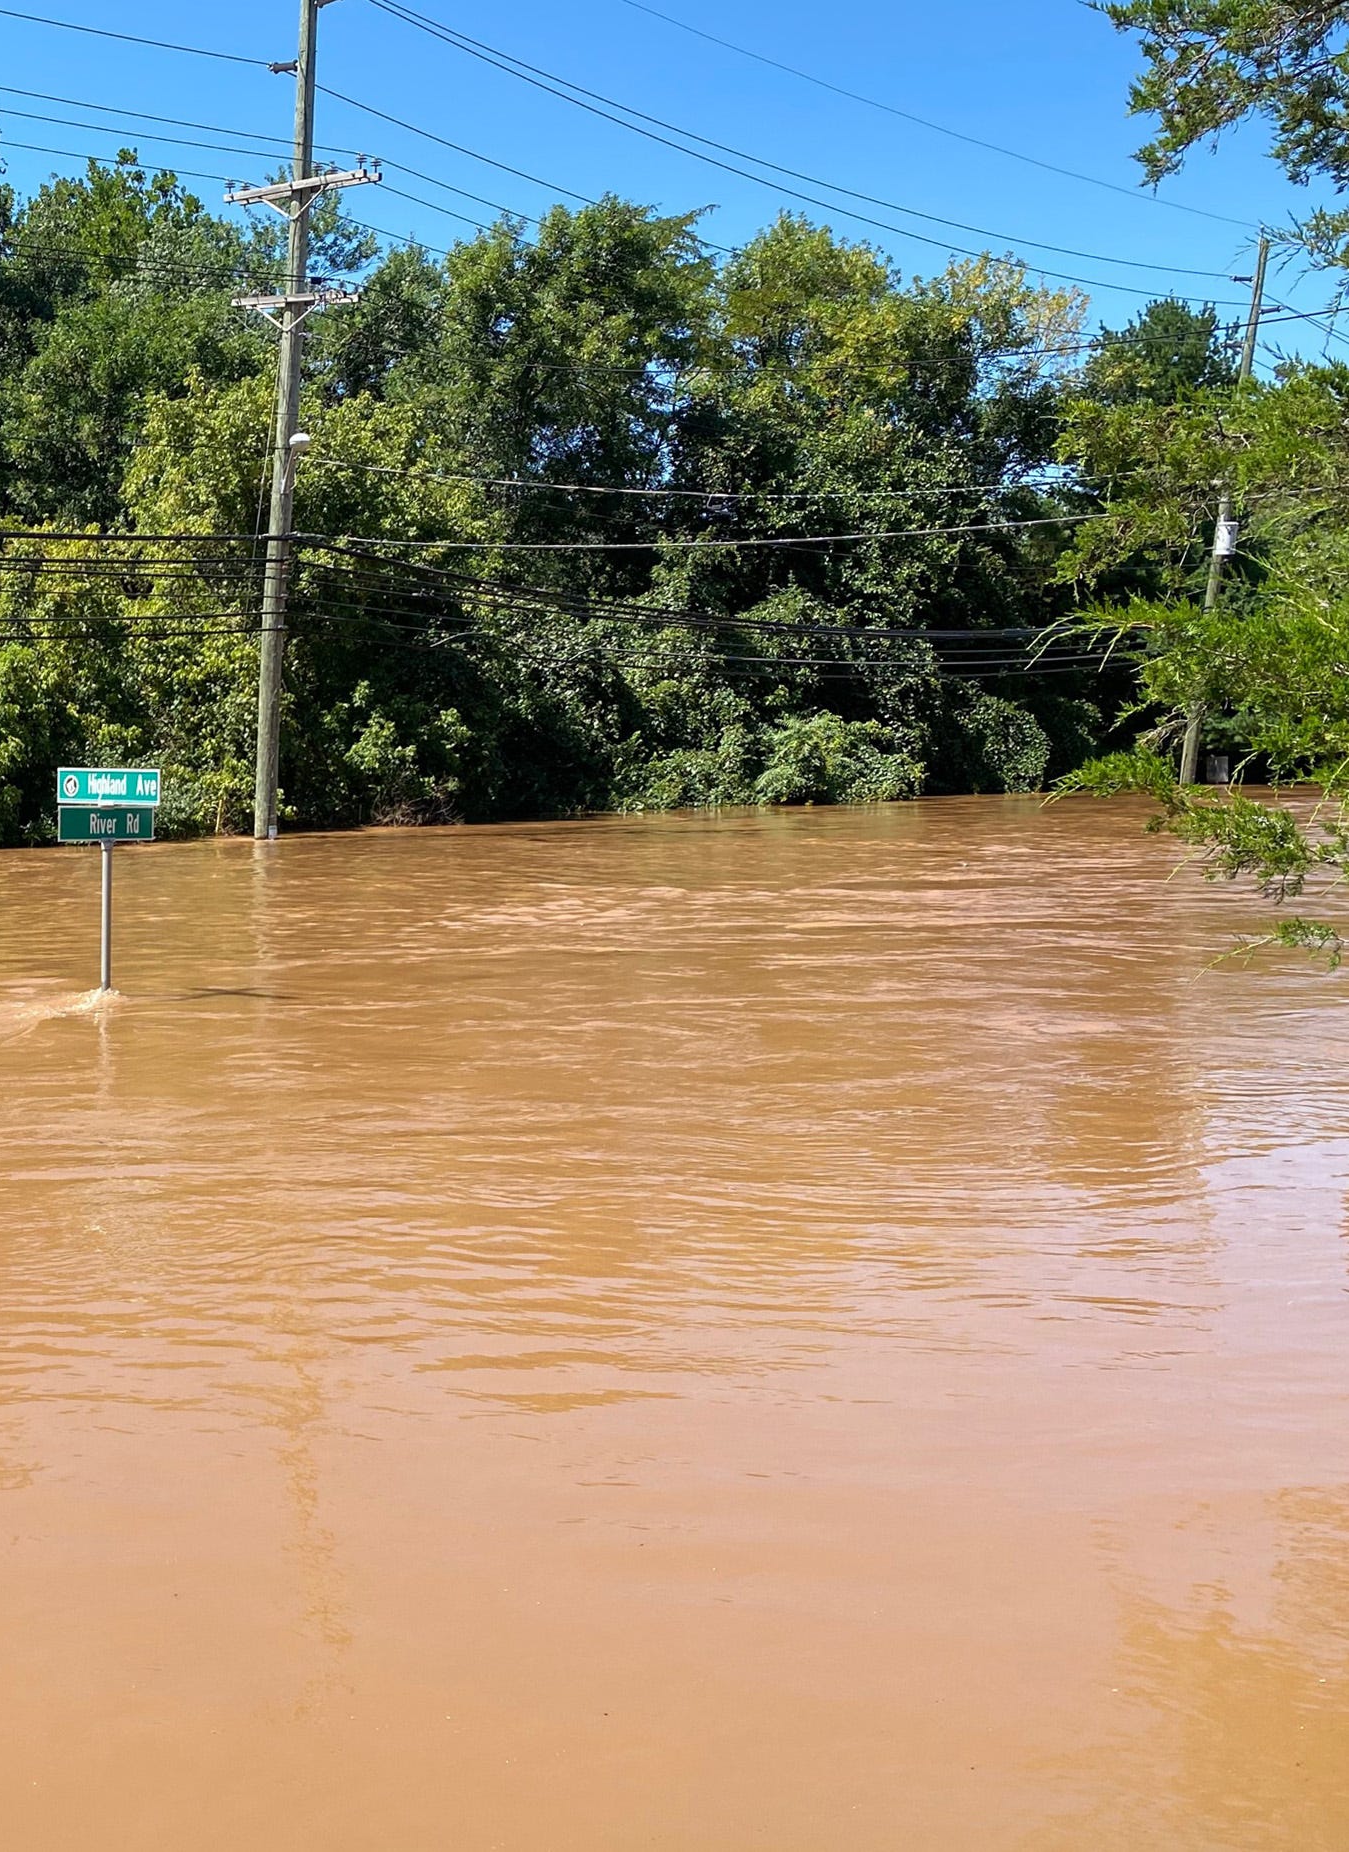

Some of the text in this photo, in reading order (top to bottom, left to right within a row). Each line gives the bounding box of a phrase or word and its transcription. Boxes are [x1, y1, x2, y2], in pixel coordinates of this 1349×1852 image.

[87, 773, 157, 799] Highland Ave
[90, 813, 140, 834] River Rd
